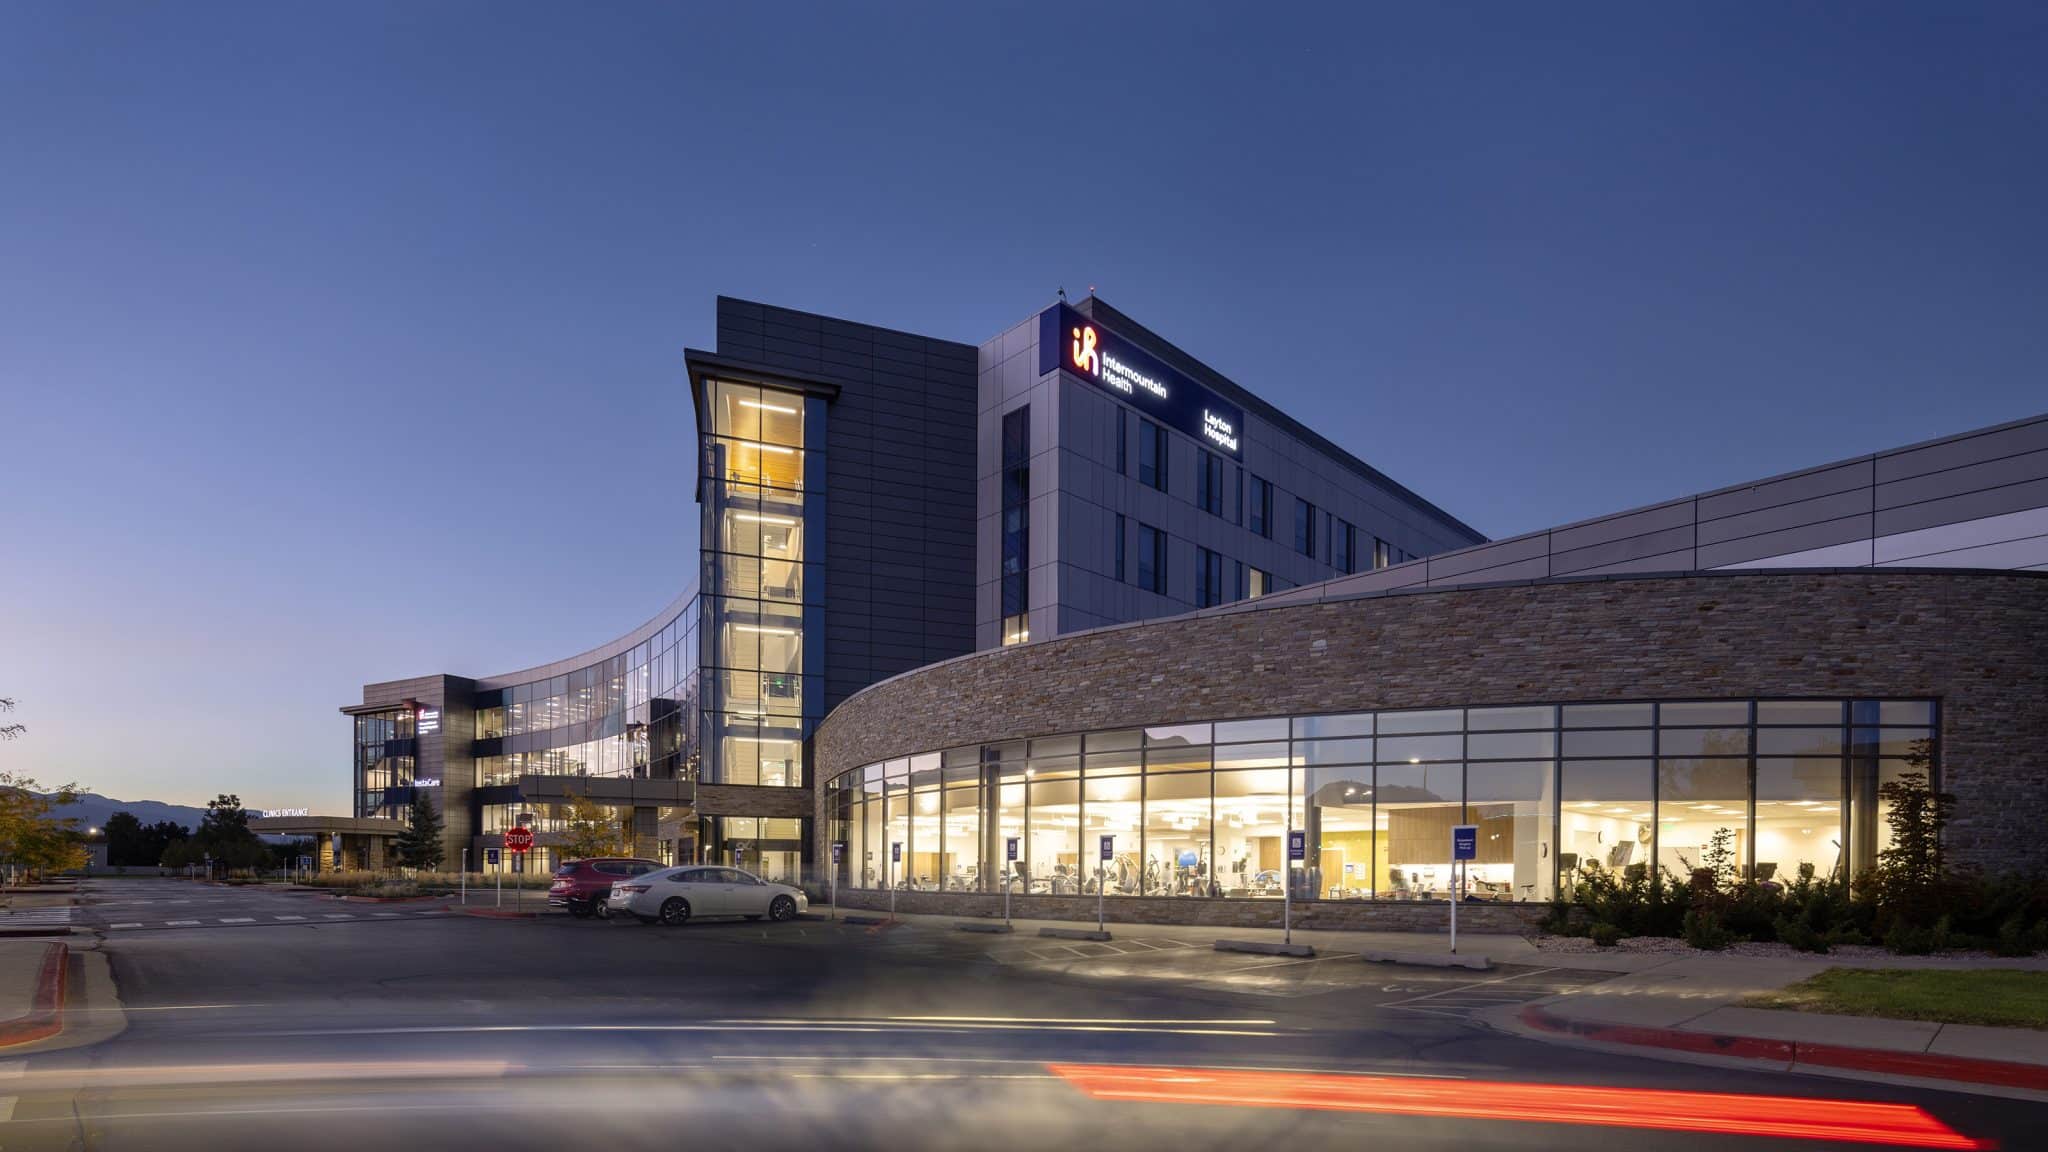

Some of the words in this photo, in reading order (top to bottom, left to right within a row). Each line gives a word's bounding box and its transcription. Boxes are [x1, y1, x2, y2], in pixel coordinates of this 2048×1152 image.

[1102, 351, 1167, 398] Intermountain
[1102, 367, 1132, 394] Health
[1204, 409, 1232, 435] Layton
[1204, 423, 1237, 450] Hospital
[262, 809, 281, 817] CLINICS
[282, 808, 308, 816] ENTRANCE
[508, 834, 531, 844] STOP
